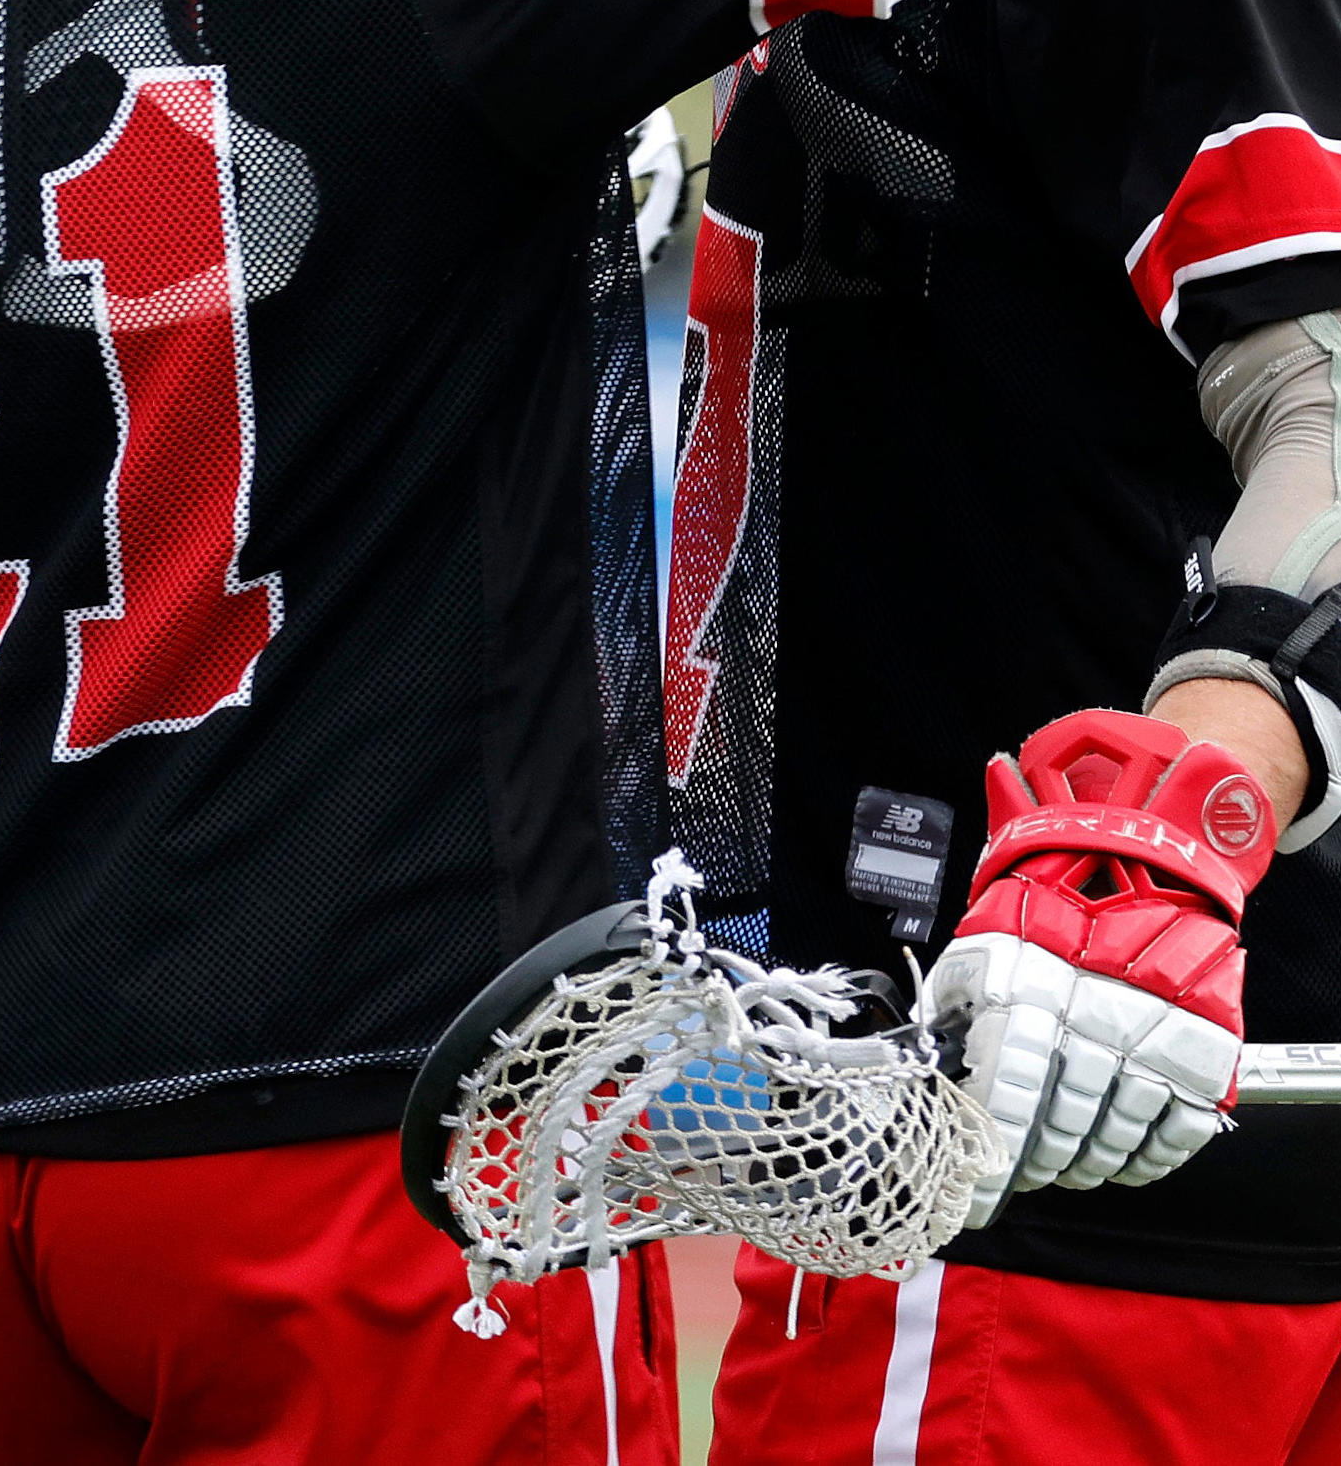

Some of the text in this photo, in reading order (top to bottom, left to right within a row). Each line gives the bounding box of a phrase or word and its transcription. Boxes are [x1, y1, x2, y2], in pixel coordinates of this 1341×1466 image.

[872, 830, 932, 851] new balance
[903, 918, 921, 934] M
